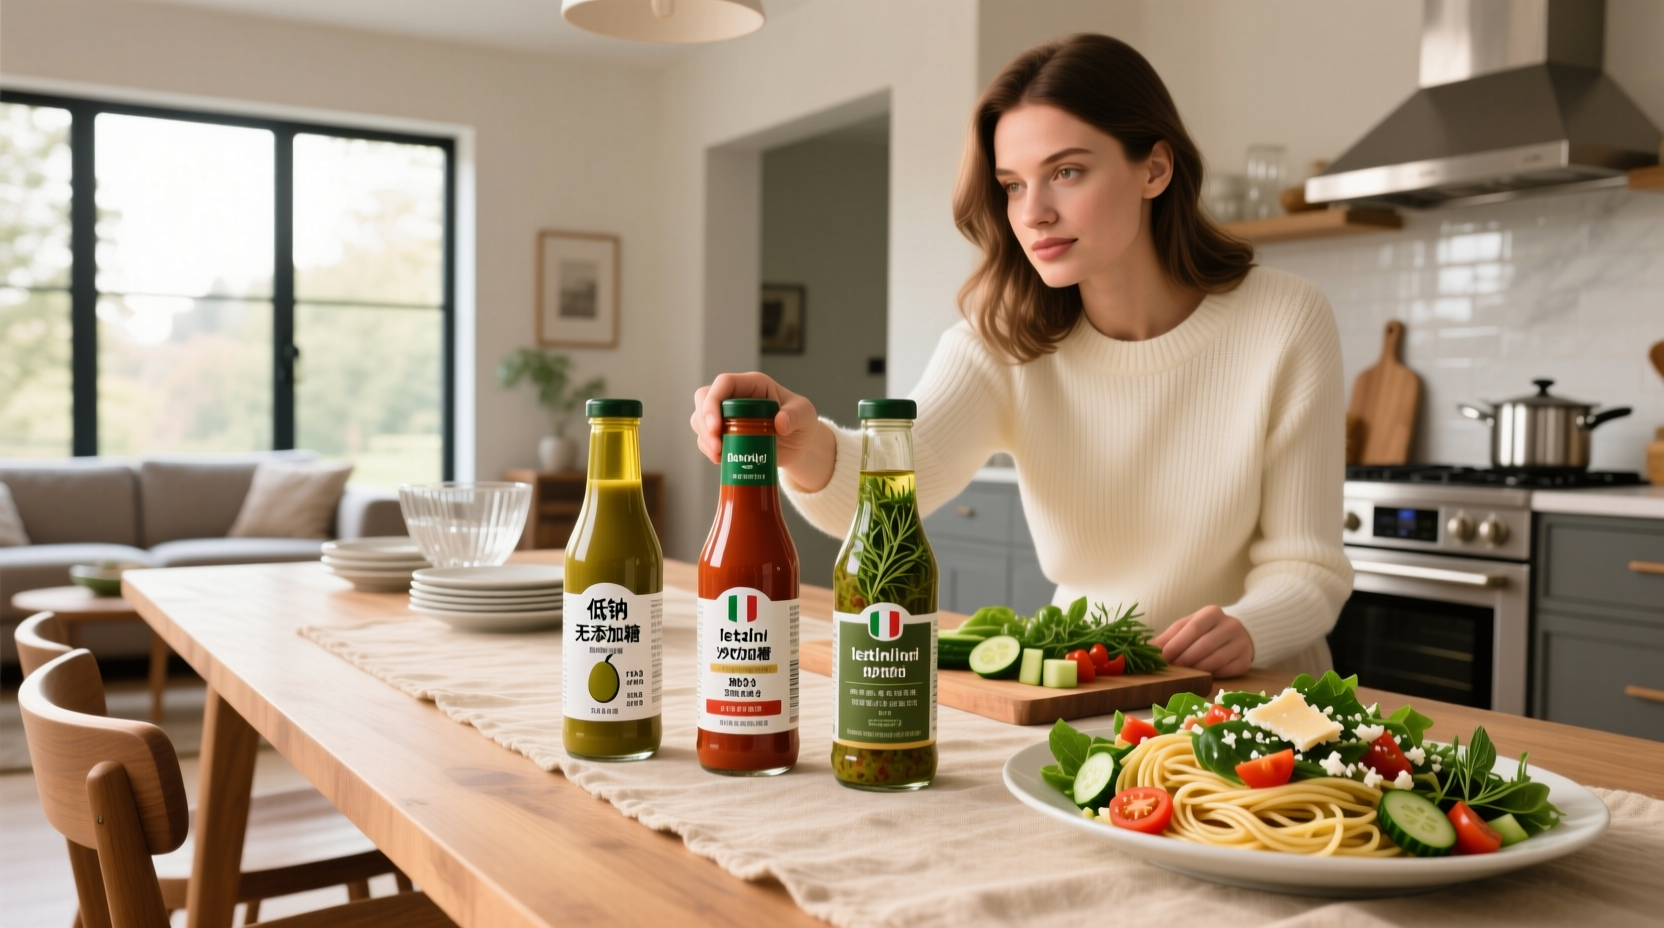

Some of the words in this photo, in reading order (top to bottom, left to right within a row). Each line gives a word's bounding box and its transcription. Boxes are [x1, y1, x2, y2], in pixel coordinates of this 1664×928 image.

[586, 597, 628, 621] 低钠
[575, 623, 641, 643] 无添加糖
